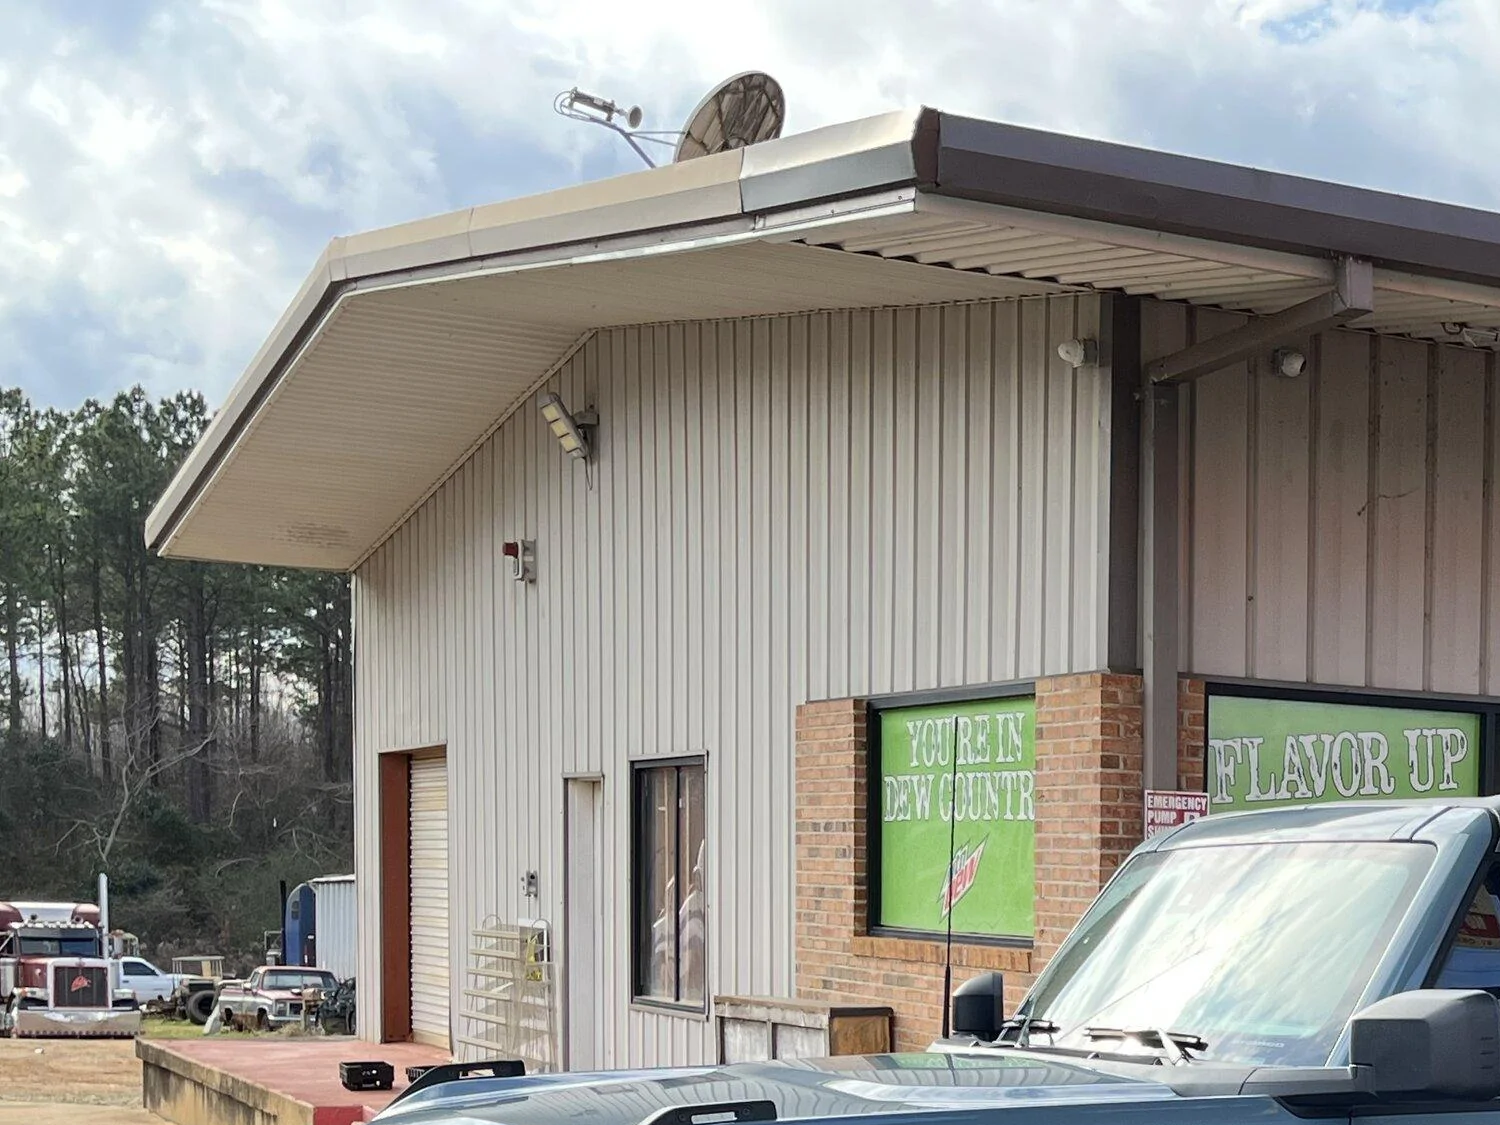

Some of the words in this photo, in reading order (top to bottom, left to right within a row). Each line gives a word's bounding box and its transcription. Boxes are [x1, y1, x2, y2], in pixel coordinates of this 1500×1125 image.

[907, 714, 991, 768] YOU'RE
[996, 712, 1025, 763] IN
[1209, 731, 1395, 804] FLAVOR
[1404, 727, 1469, 792] UP
[884, 774, 935, 822] DEW
[939, 770, 1036, 823] COUNTR
[1147, 795, 1207, 811] EMERGENCY
[1147, 810, 1177, 824] PUMP
